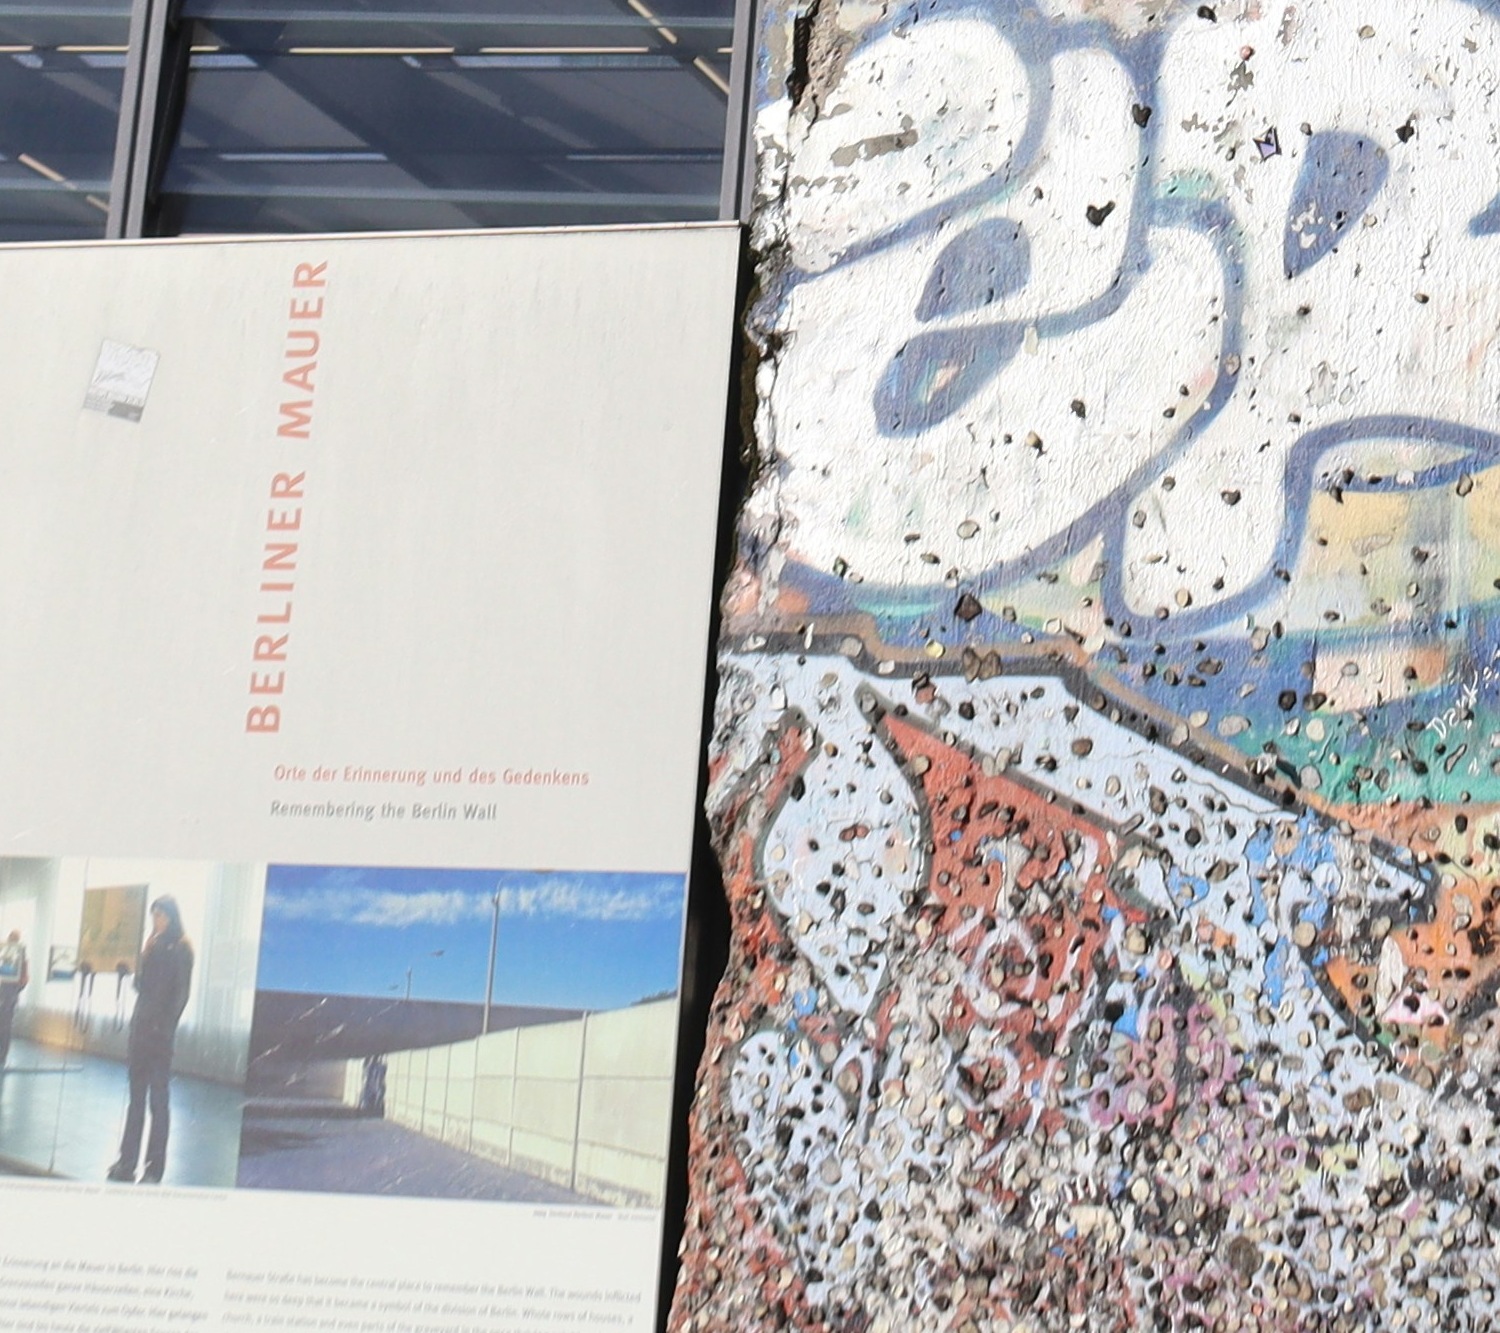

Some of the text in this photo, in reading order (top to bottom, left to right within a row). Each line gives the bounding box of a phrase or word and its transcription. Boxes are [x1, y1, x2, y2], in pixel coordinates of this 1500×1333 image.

[245, 259, 329, 734] BERLINER MAUER
[274, 764, 589, 787] Orte der Erinnerung und des Gedenkens
[270, 800, 497, 821] Remembering the Berlin Wall
